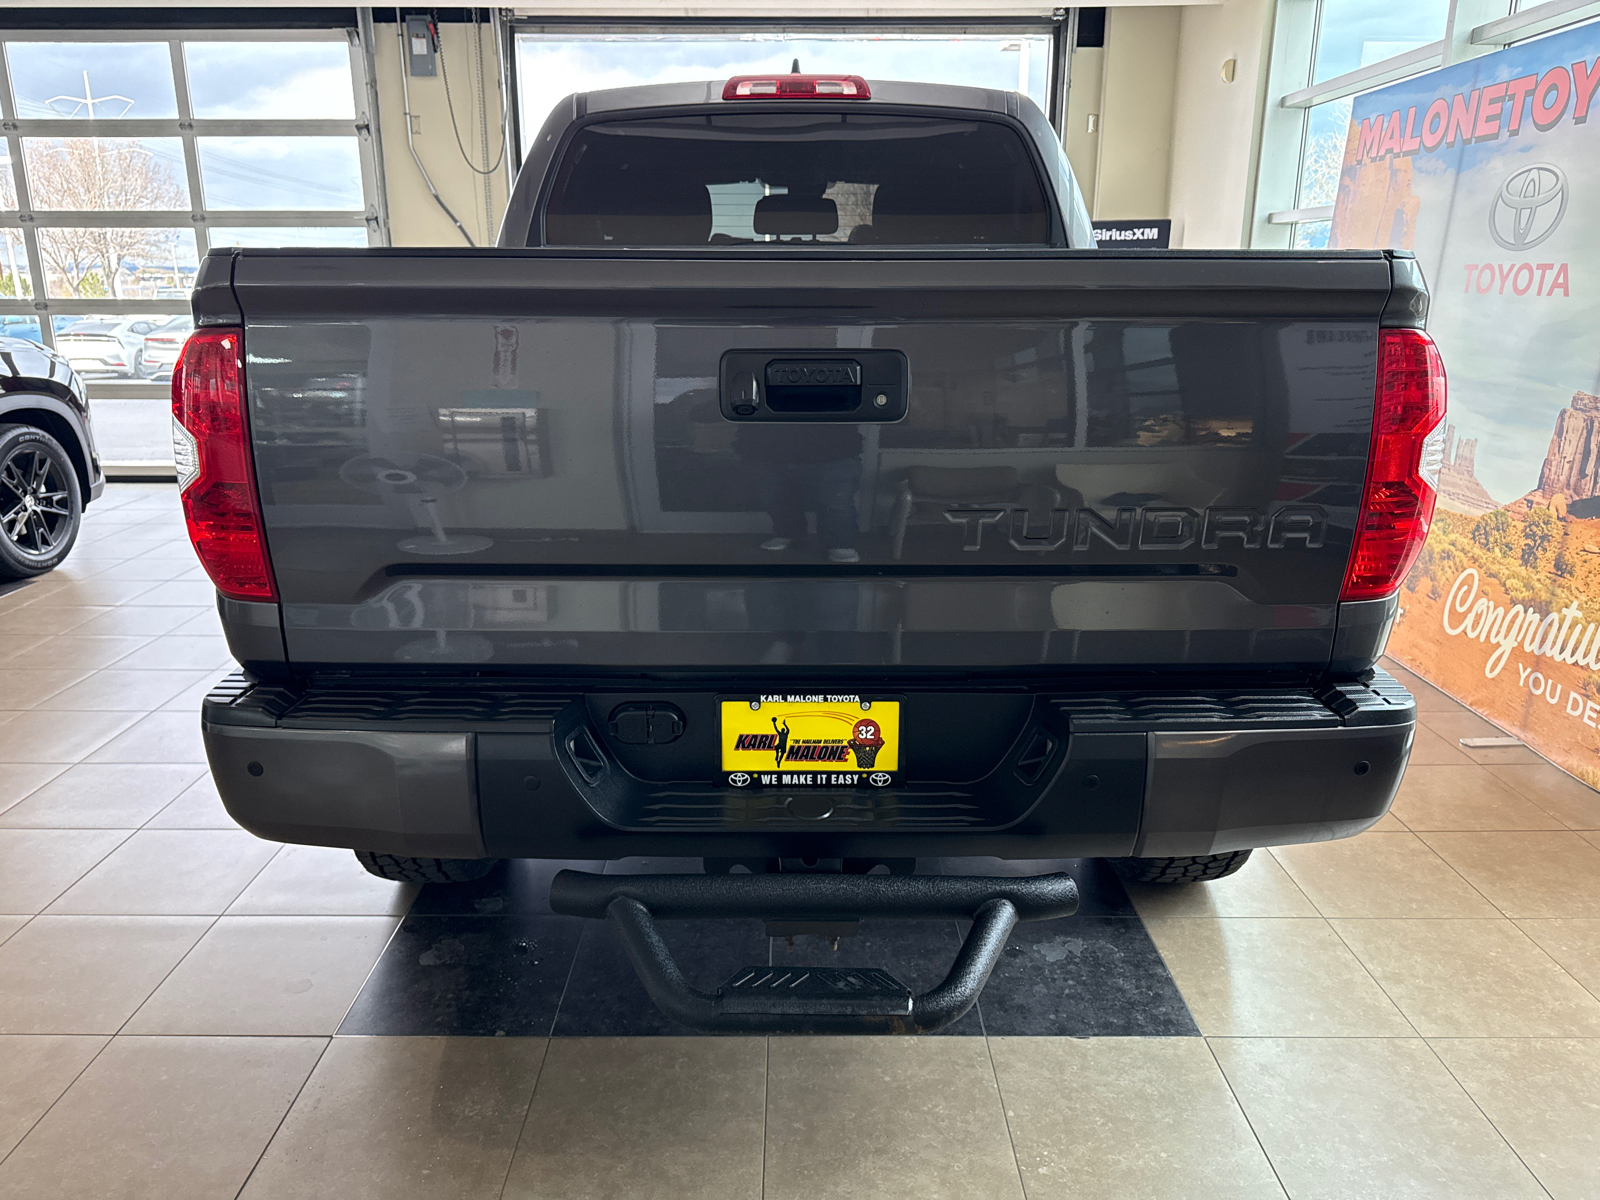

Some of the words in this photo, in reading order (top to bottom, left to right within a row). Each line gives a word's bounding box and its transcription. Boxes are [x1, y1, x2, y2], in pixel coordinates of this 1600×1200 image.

[1093, 227, 1159, 241] SiriusXM
[1463, 262, 1570, 297] TOYOTA
[775, 367, 855, 384] TOYOTA
[942, 505, 1331, 551] TUNDRA
[760, 695, 784, 703] KARL
[787, 695, 824, 703] MALONE
[826, 695, 860, 703] TOYOTA
[1518, 662, 1562, 704] YOU
[1566, 690, 1600, 730] DE
[858, 725, 875, 739] 32
[734, 734, 778, 751] KARL
[785, 745, 850, 762] MALONE
[761, 774, 778, 785] WE
[782, 774, 813, 785] MAKE
[817, 774, 828, 785] IT
[831, 774, 859, 785] EASY
